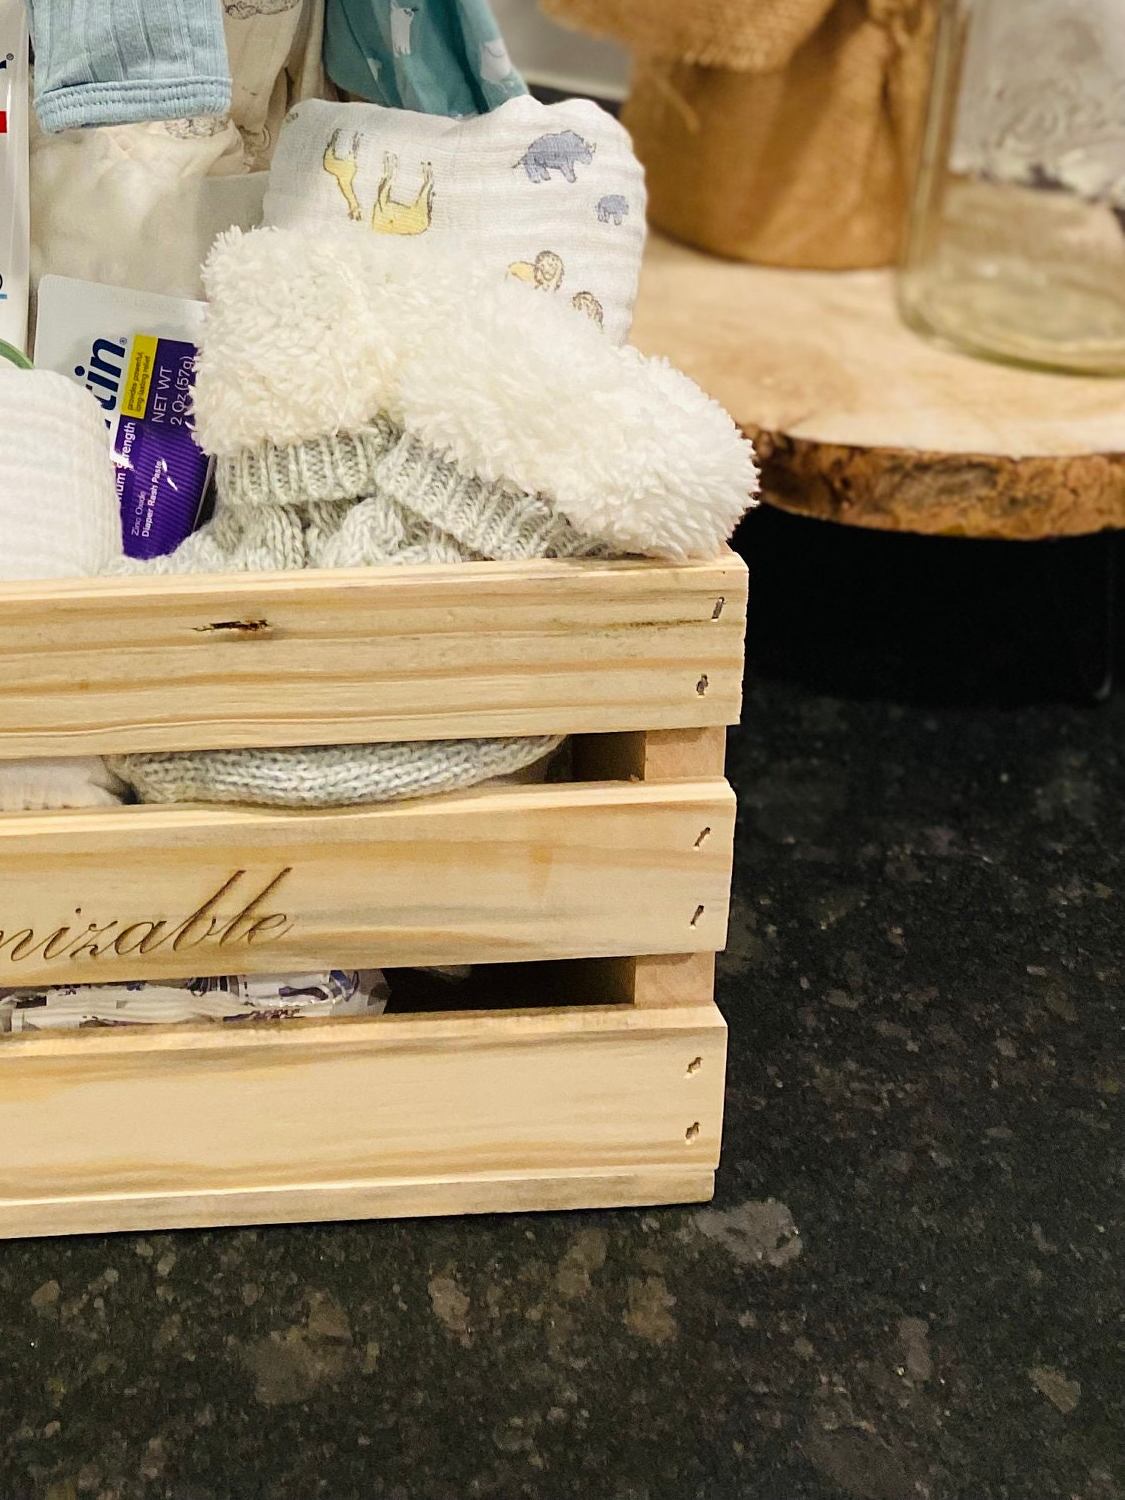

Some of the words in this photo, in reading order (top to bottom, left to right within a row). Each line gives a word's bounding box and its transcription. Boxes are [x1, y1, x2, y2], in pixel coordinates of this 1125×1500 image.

[142, 355, 151, 373] relief
[156, 365, 173, 390] WT
[174, 356, 194, 391] (57g)
[74, 338, 126, 428] tin
[127, 382, 138, 411] provides
[136, 373, 150, 412] long-lasting
[151, 393, 168, 423] NET
[171, 394, 187, 413] Oz
[170, 416, 183, 426] 2
[147, 485, 159, 507] Rash
[131, 518, 142, 537] Zinc
[142, 508, 154, 538] Diaper
